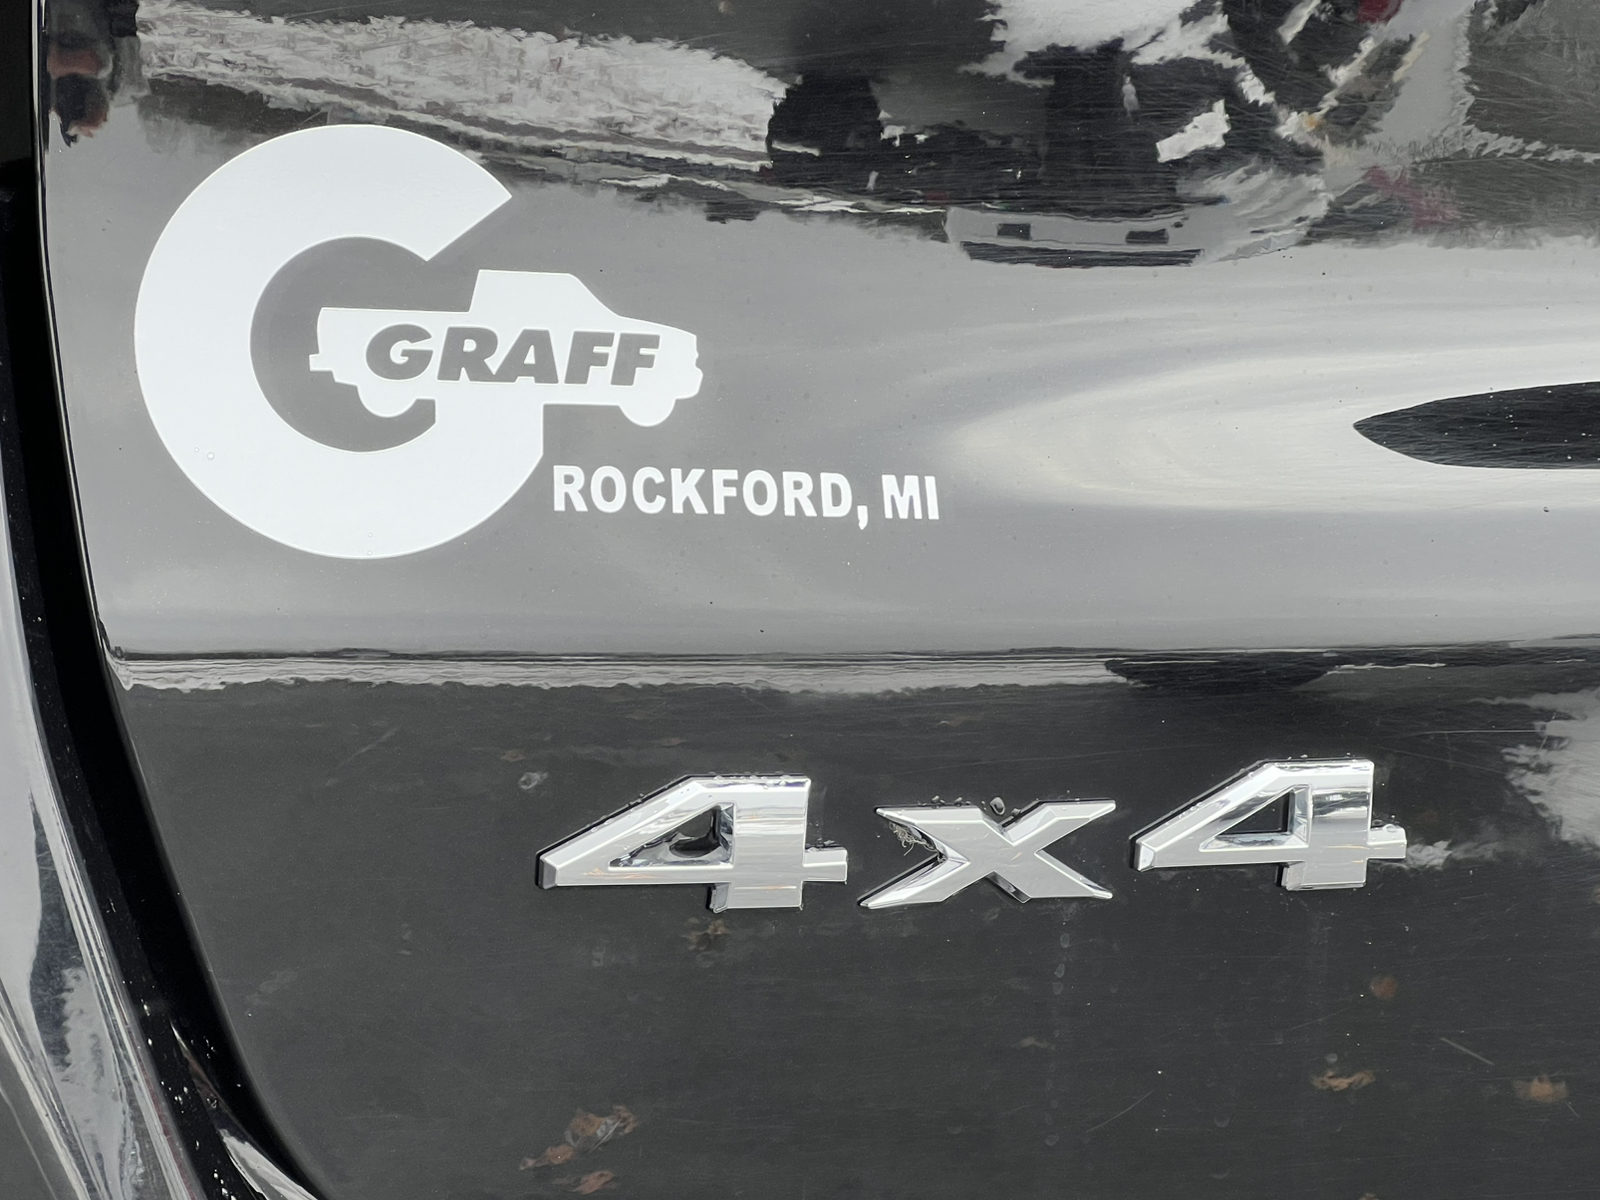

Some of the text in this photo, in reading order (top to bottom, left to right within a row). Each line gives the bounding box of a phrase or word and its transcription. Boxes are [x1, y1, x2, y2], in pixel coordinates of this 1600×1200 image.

[366, 323, 661, 387] GRAFF
[551, 464, 940, 530] ROCKFORD, MI
